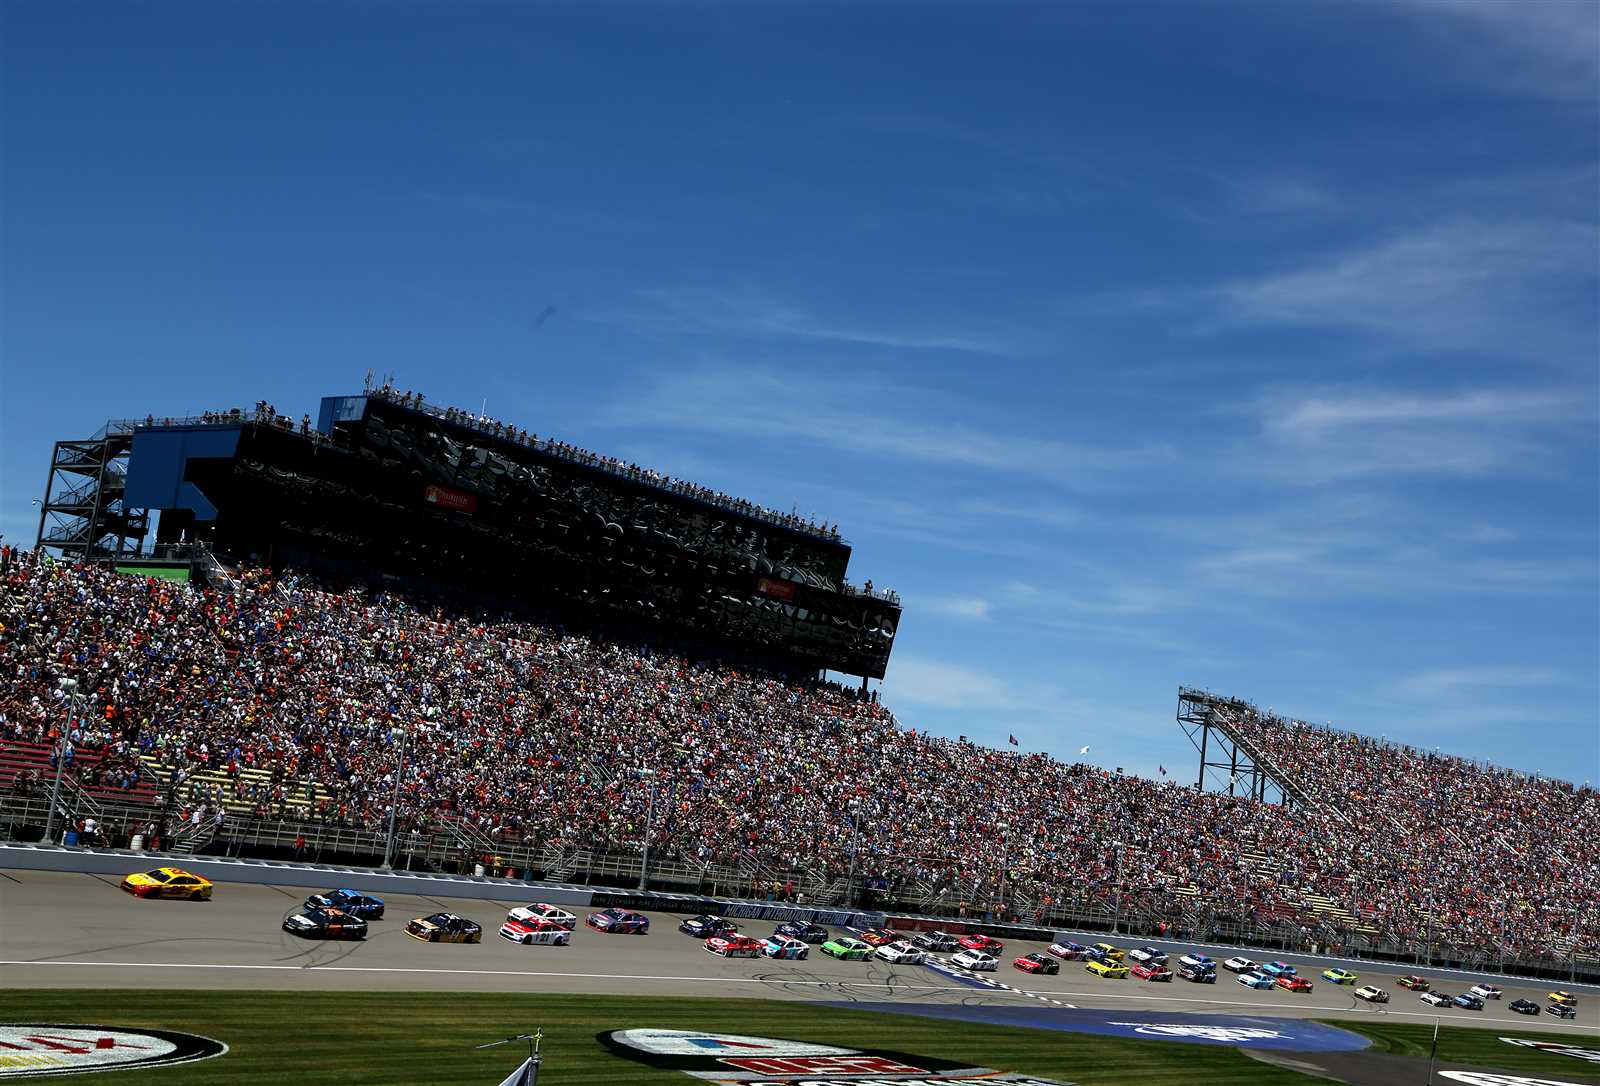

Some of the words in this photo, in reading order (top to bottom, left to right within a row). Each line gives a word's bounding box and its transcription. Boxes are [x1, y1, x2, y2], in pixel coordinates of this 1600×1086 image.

[723, 904, 762, 920] MICHIGAN
[762, 906, 814, 923] INTERNATIONAL
[817, 911, 849, 926] SPEEDWAY
